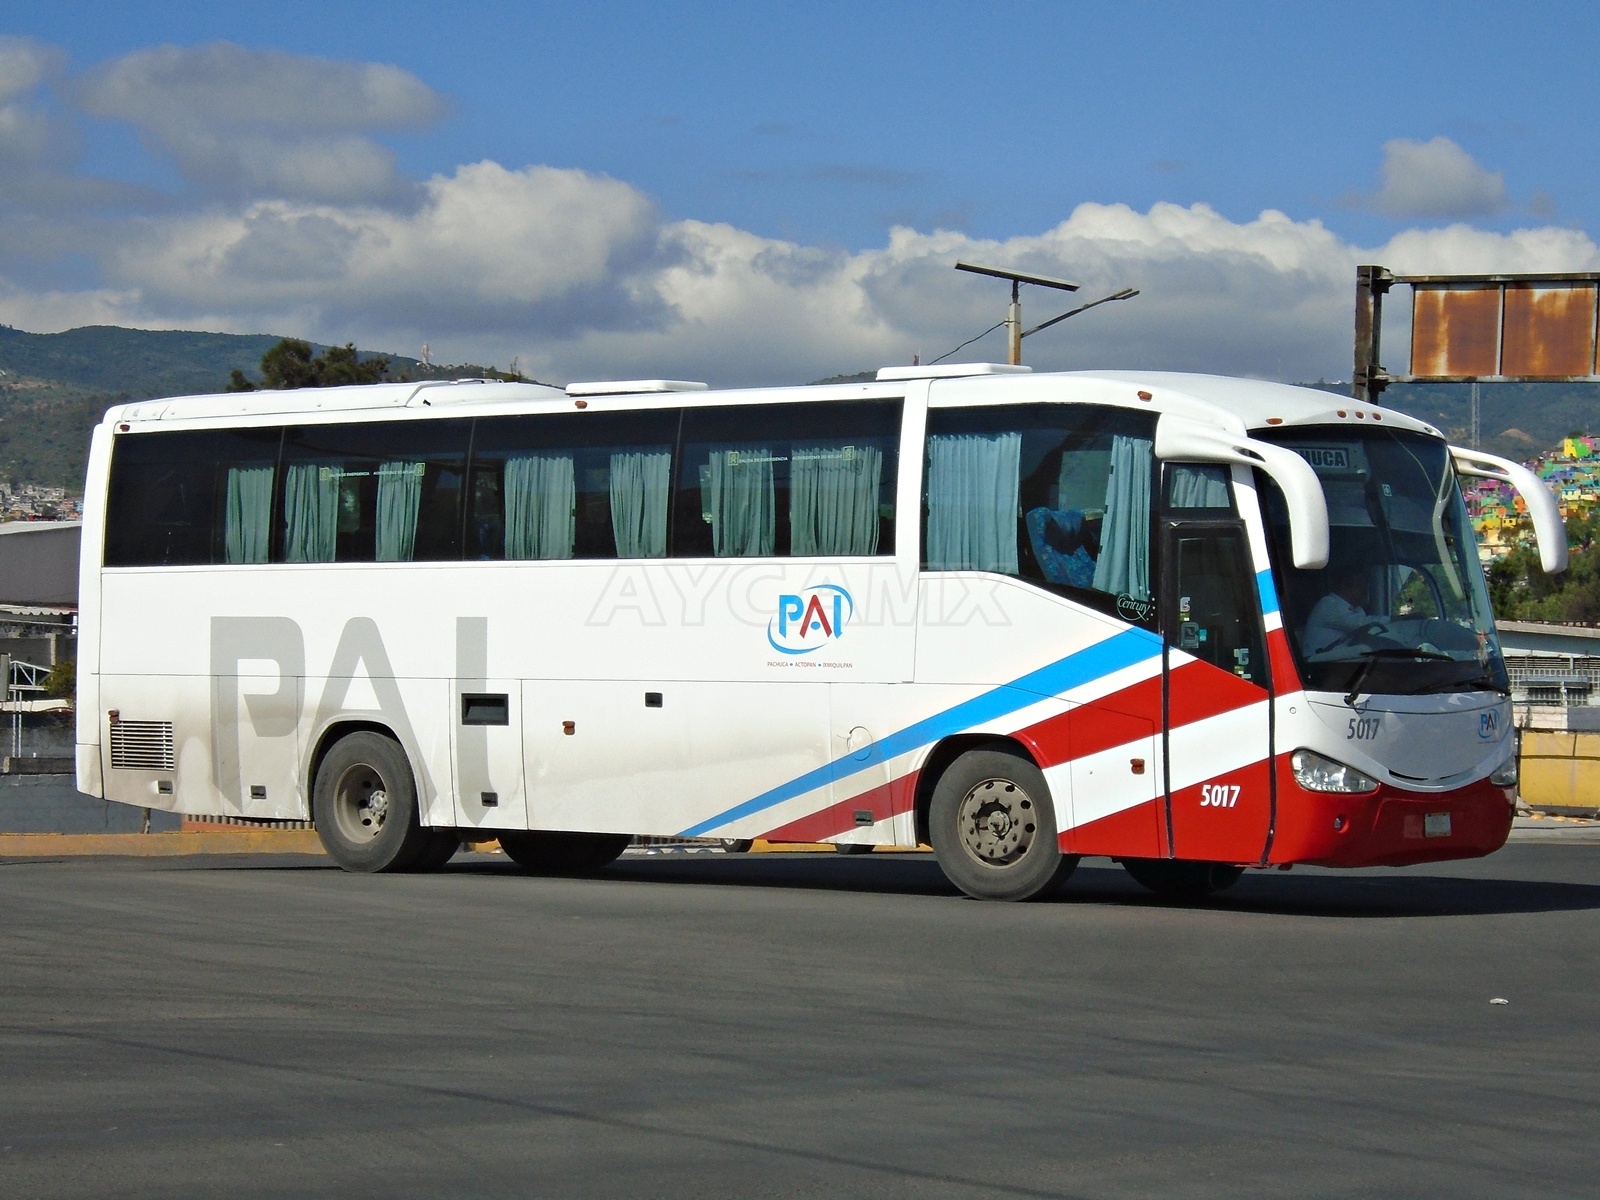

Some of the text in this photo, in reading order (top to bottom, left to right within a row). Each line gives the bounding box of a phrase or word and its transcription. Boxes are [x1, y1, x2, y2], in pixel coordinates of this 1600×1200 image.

[778, 594, 843, 639] PAI
[1117, 597, 1151, 616] Century
[210, 616, 498, 827] PAI
[1347, 718, 1380, 740] 5017
[1480, 713, 1498, 731] PAI
[1200, 784, 1241, 808] 5017
